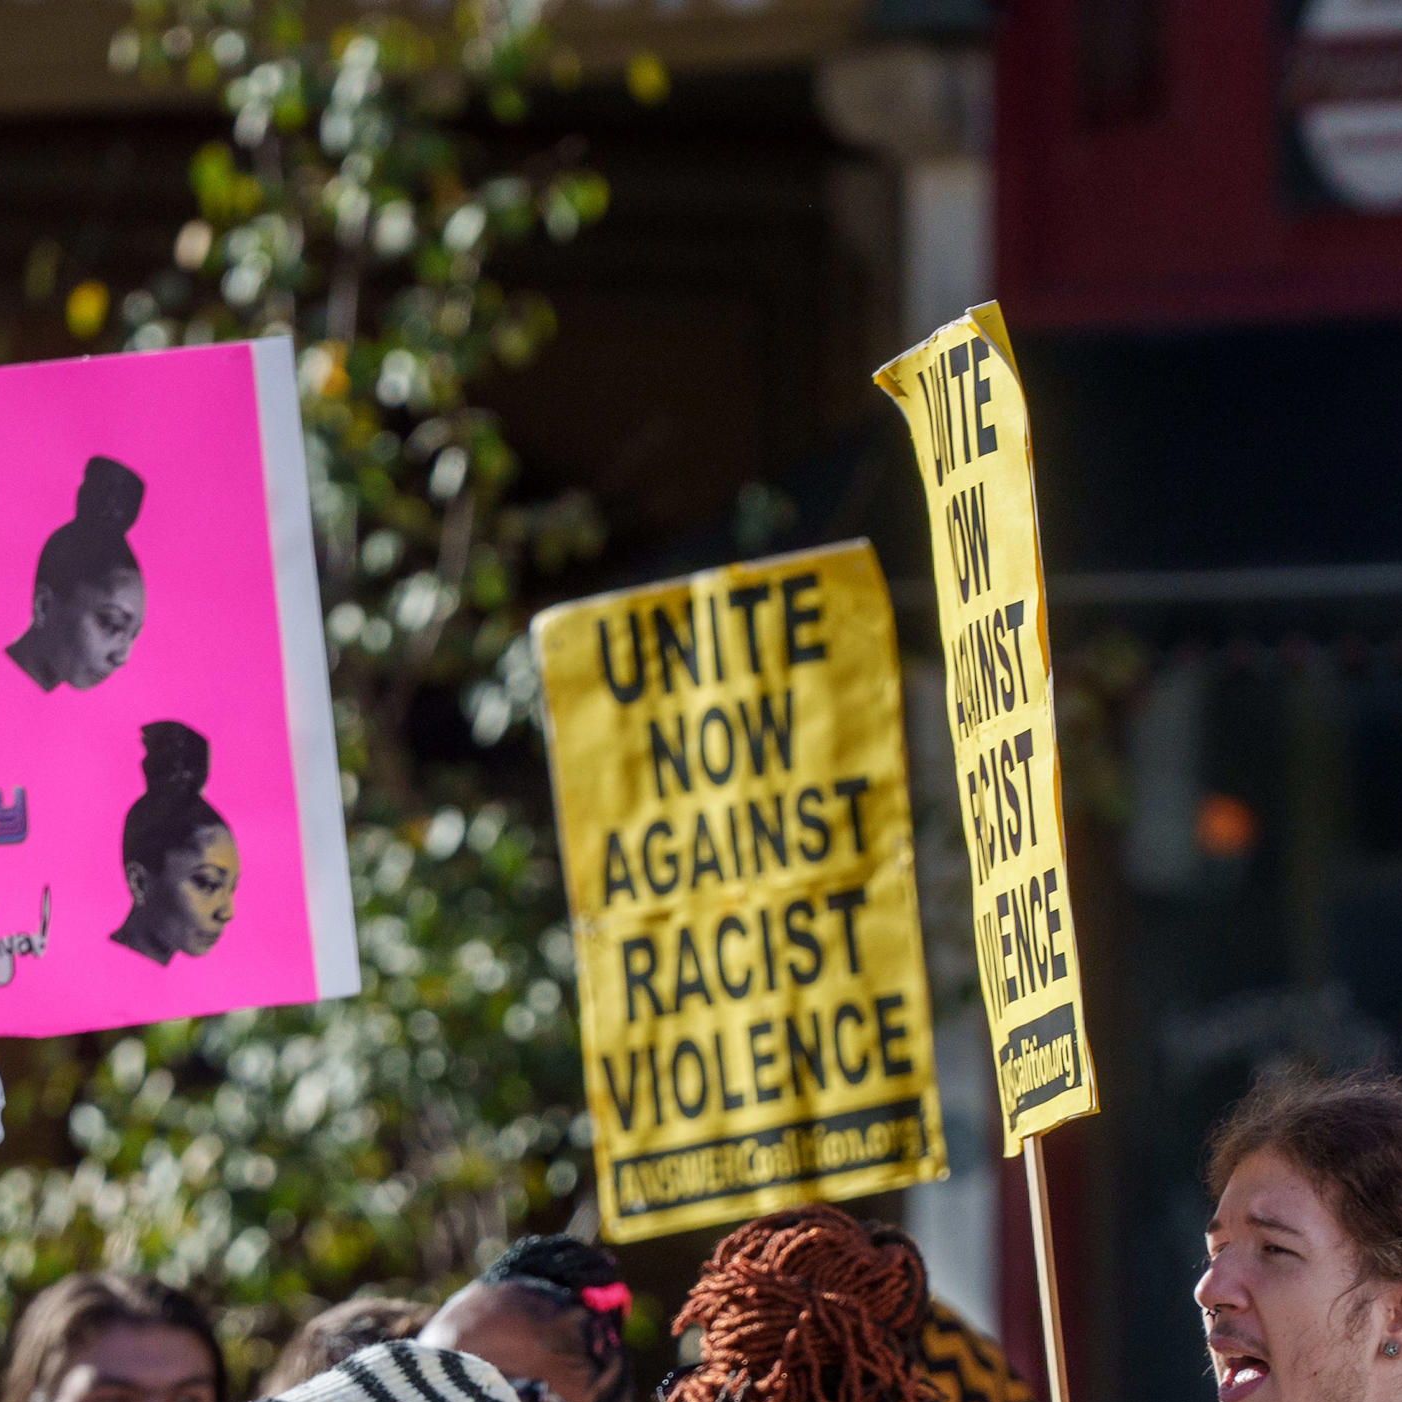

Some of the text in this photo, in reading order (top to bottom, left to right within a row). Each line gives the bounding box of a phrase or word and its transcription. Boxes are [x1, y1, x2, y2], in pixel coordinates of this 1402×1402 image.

[599, 570, 826, 704] UNITE
[648, 687, 795, 798] NOW
[602, 776, 871, 907] AGAINST
[622, 889, 867, 1023] RACIST
[601, 993, 913, 1132] VIOLENCE
